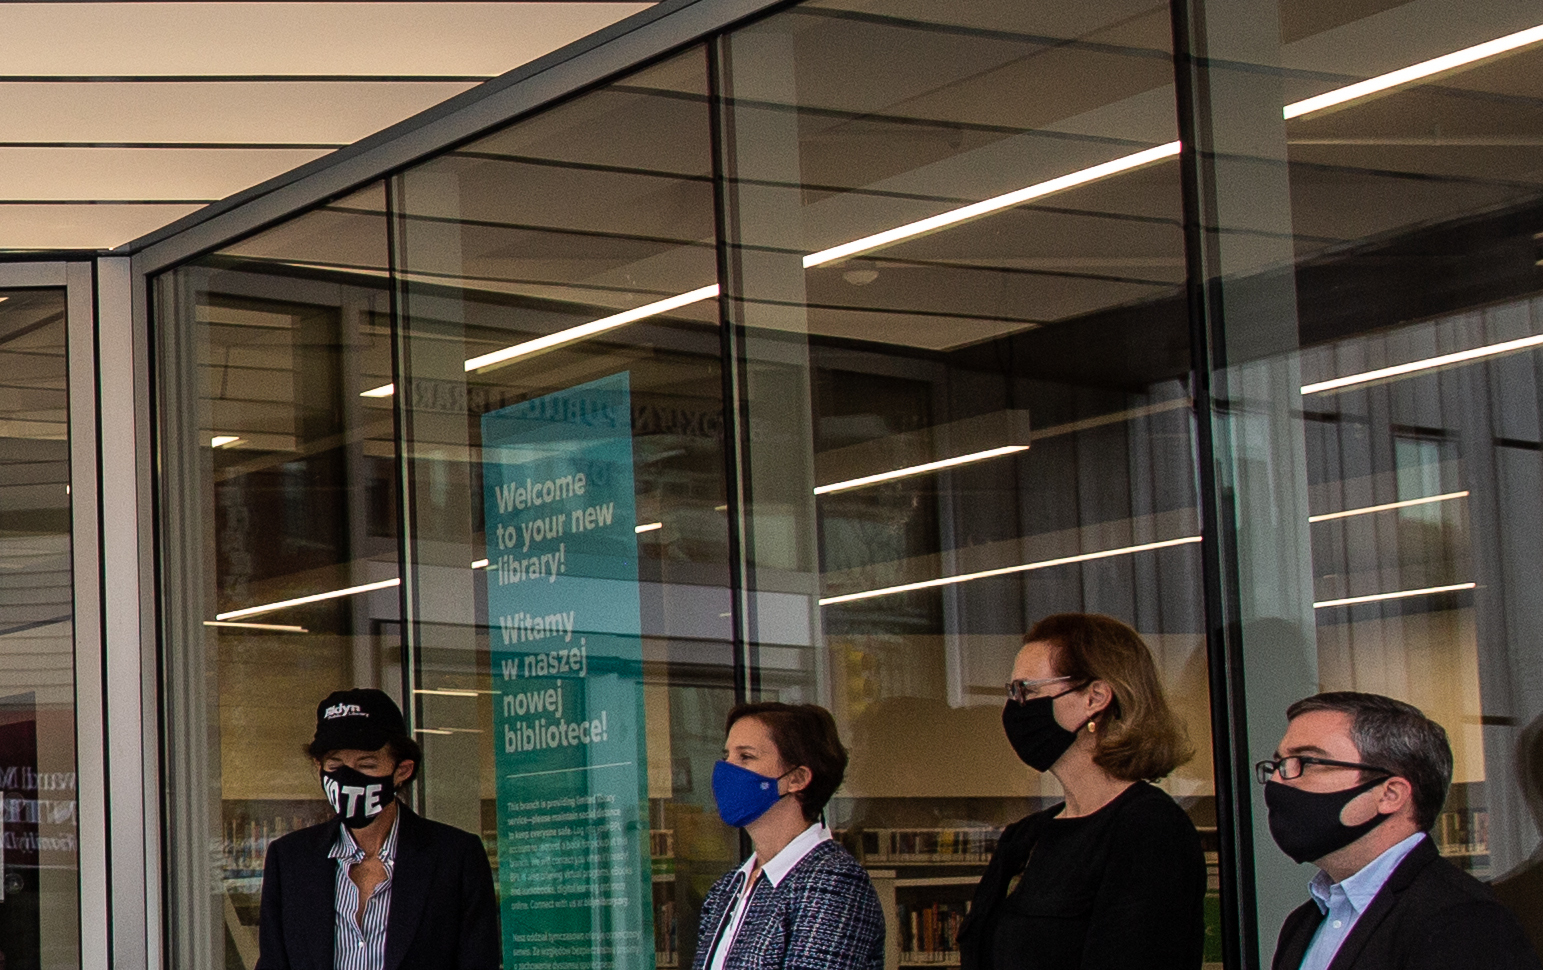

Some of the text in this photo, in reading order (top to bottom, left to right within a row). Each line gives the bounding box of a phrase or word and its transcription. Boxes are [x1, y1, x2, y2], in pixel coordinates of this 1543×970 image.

[495, 471, 586, 514] Welcome
[496, 501, 614, 554] to your new
[497, 544, 566, 586] library!
[499, 610, 575, 646] Witamy
[502, 637, 588, 681] w naszej
[503, 679, 564, 718] nowej
[504, 710, 608, 753] bibliotece!
[323, 775, 383, 819] VOTE
